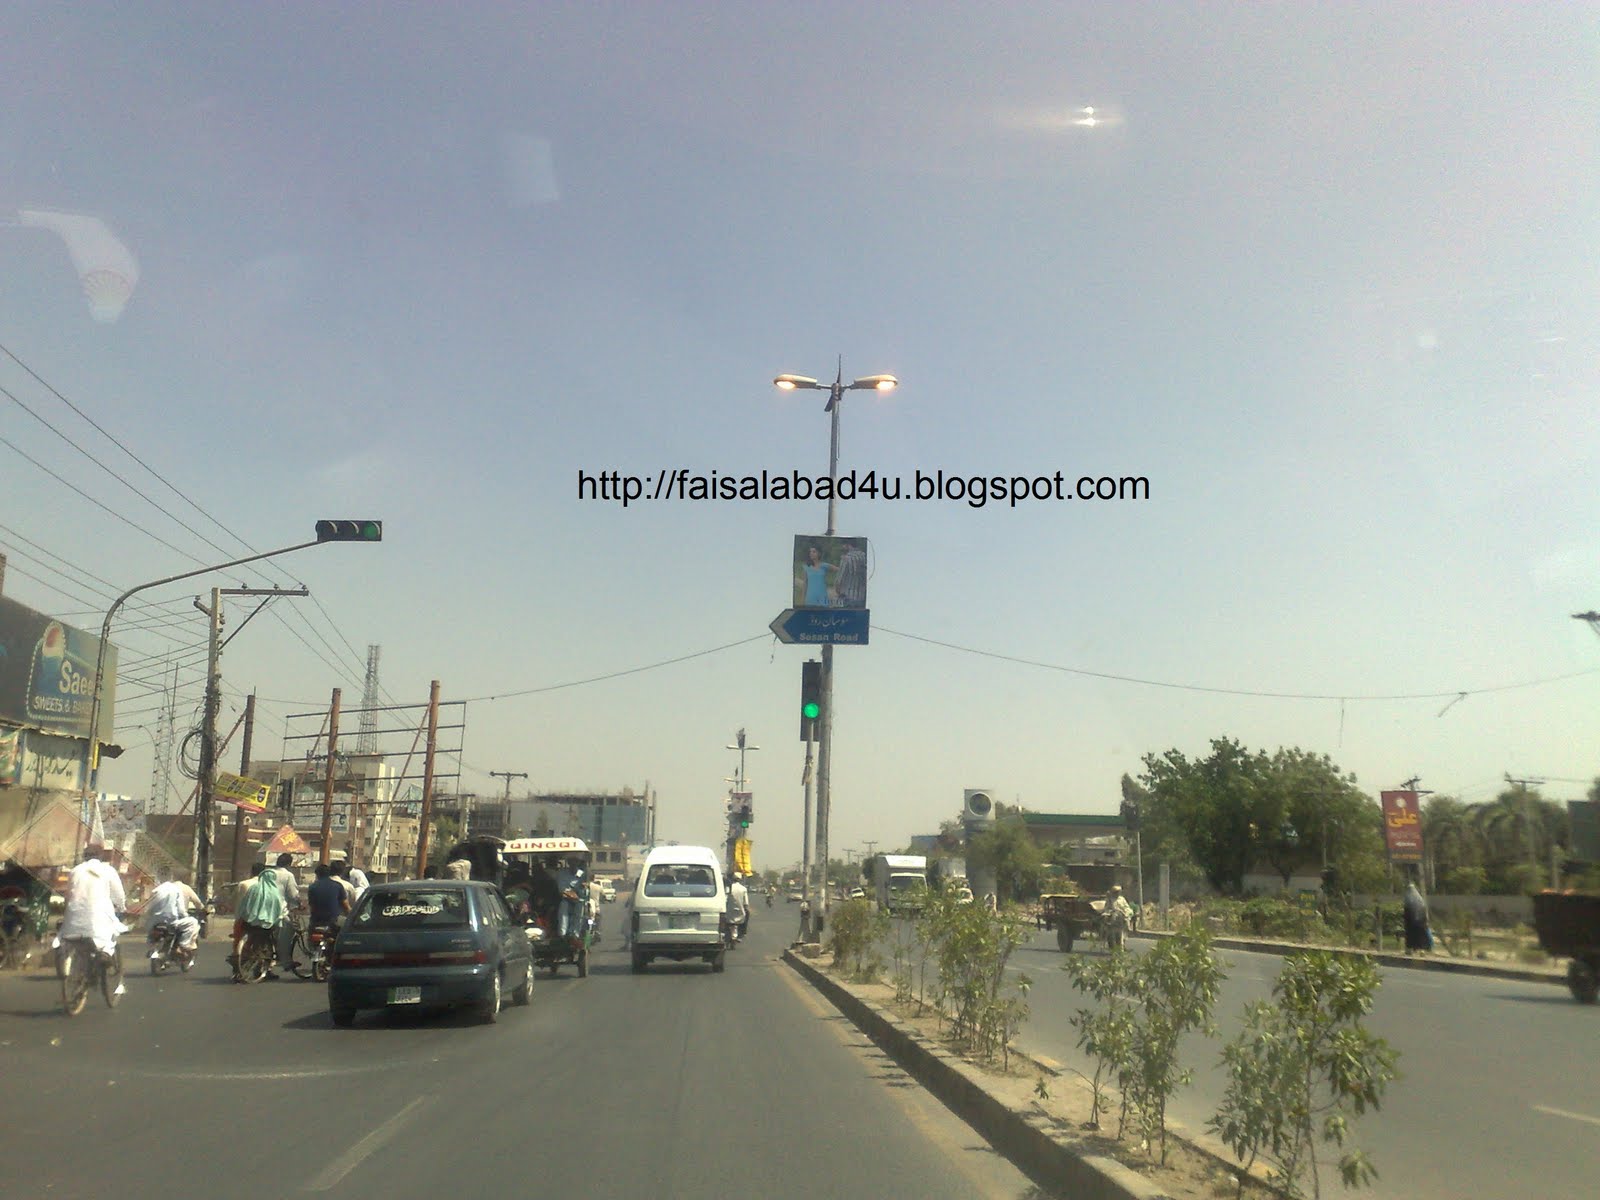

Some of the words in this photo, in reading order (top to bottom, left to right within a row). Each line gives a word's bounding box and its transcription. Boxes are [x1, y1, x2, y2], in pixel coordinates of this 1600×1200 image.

[833, 633, 859, 641] Road
[59, 660, 98, 697] Saee
[33, 696, 63, 712] SWEETS
[510, 841, 577, 849] QINGQI
